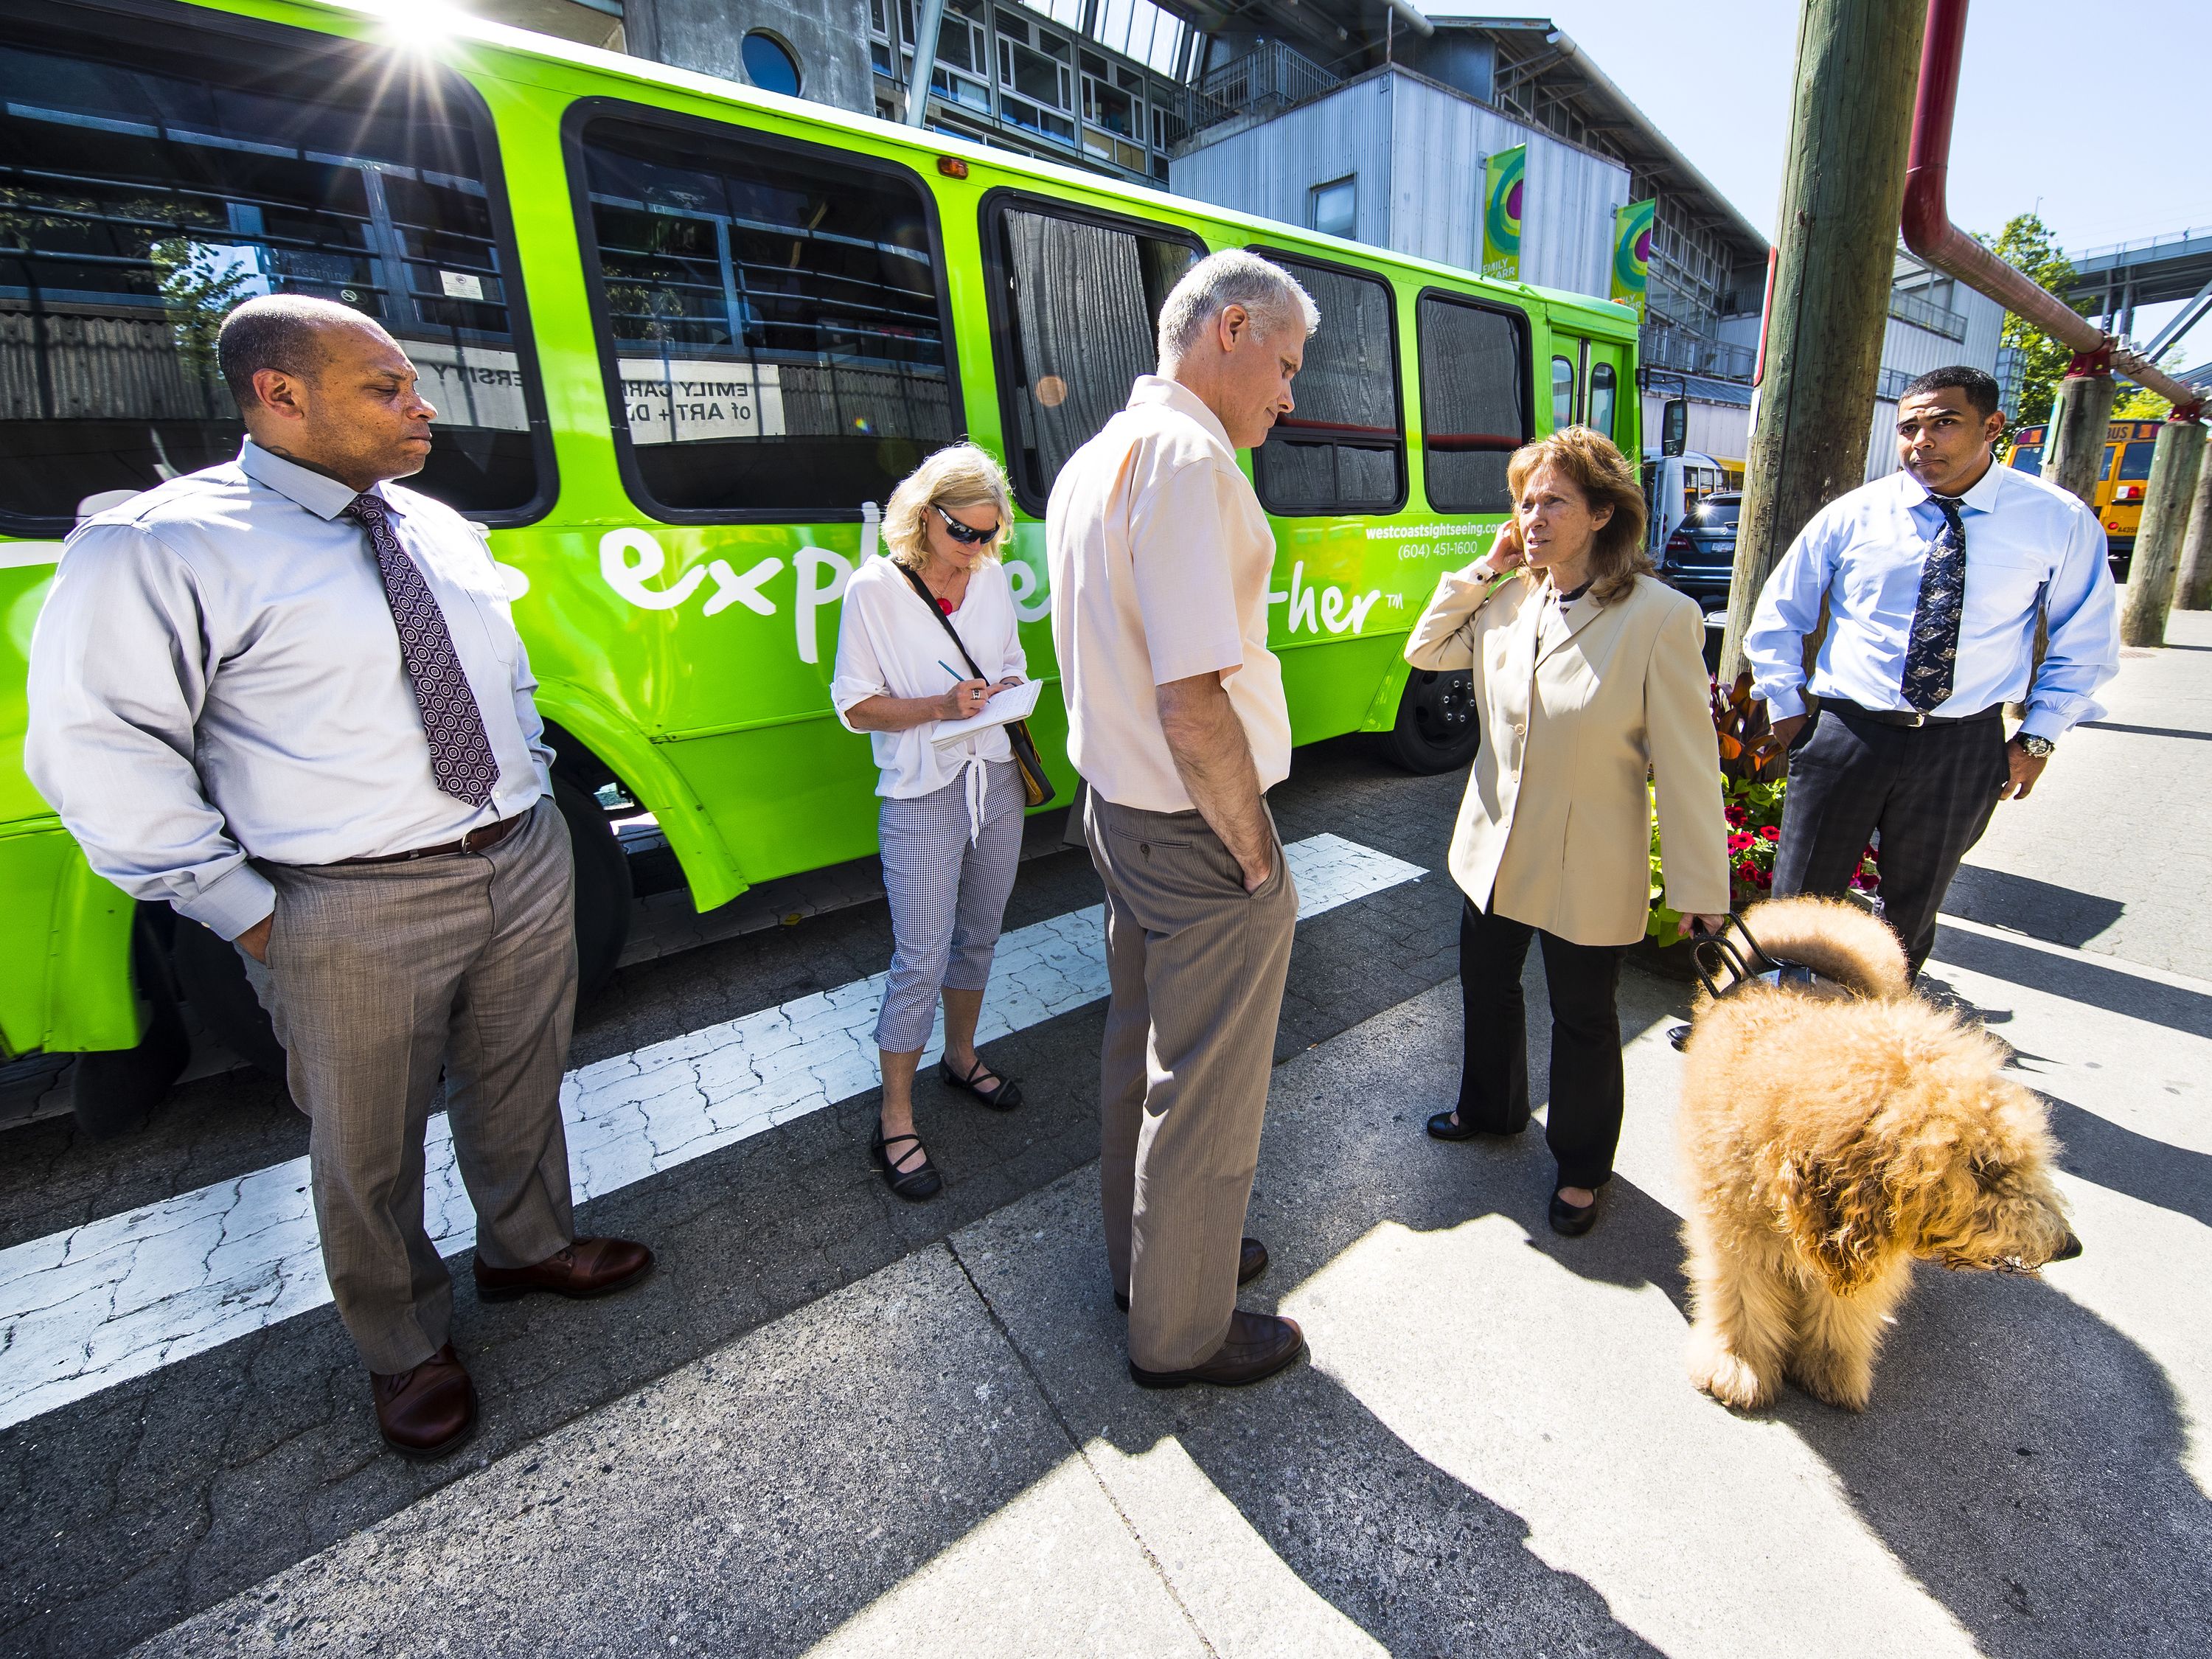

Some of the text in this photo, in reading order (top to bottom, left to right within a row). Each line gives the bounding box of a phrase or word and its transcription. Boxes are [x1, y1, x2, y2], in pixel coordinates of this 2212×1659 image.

[1483, 257, 1508, 274] EMILY
[1398, 540, 1478, 560] (604) 451-1600
